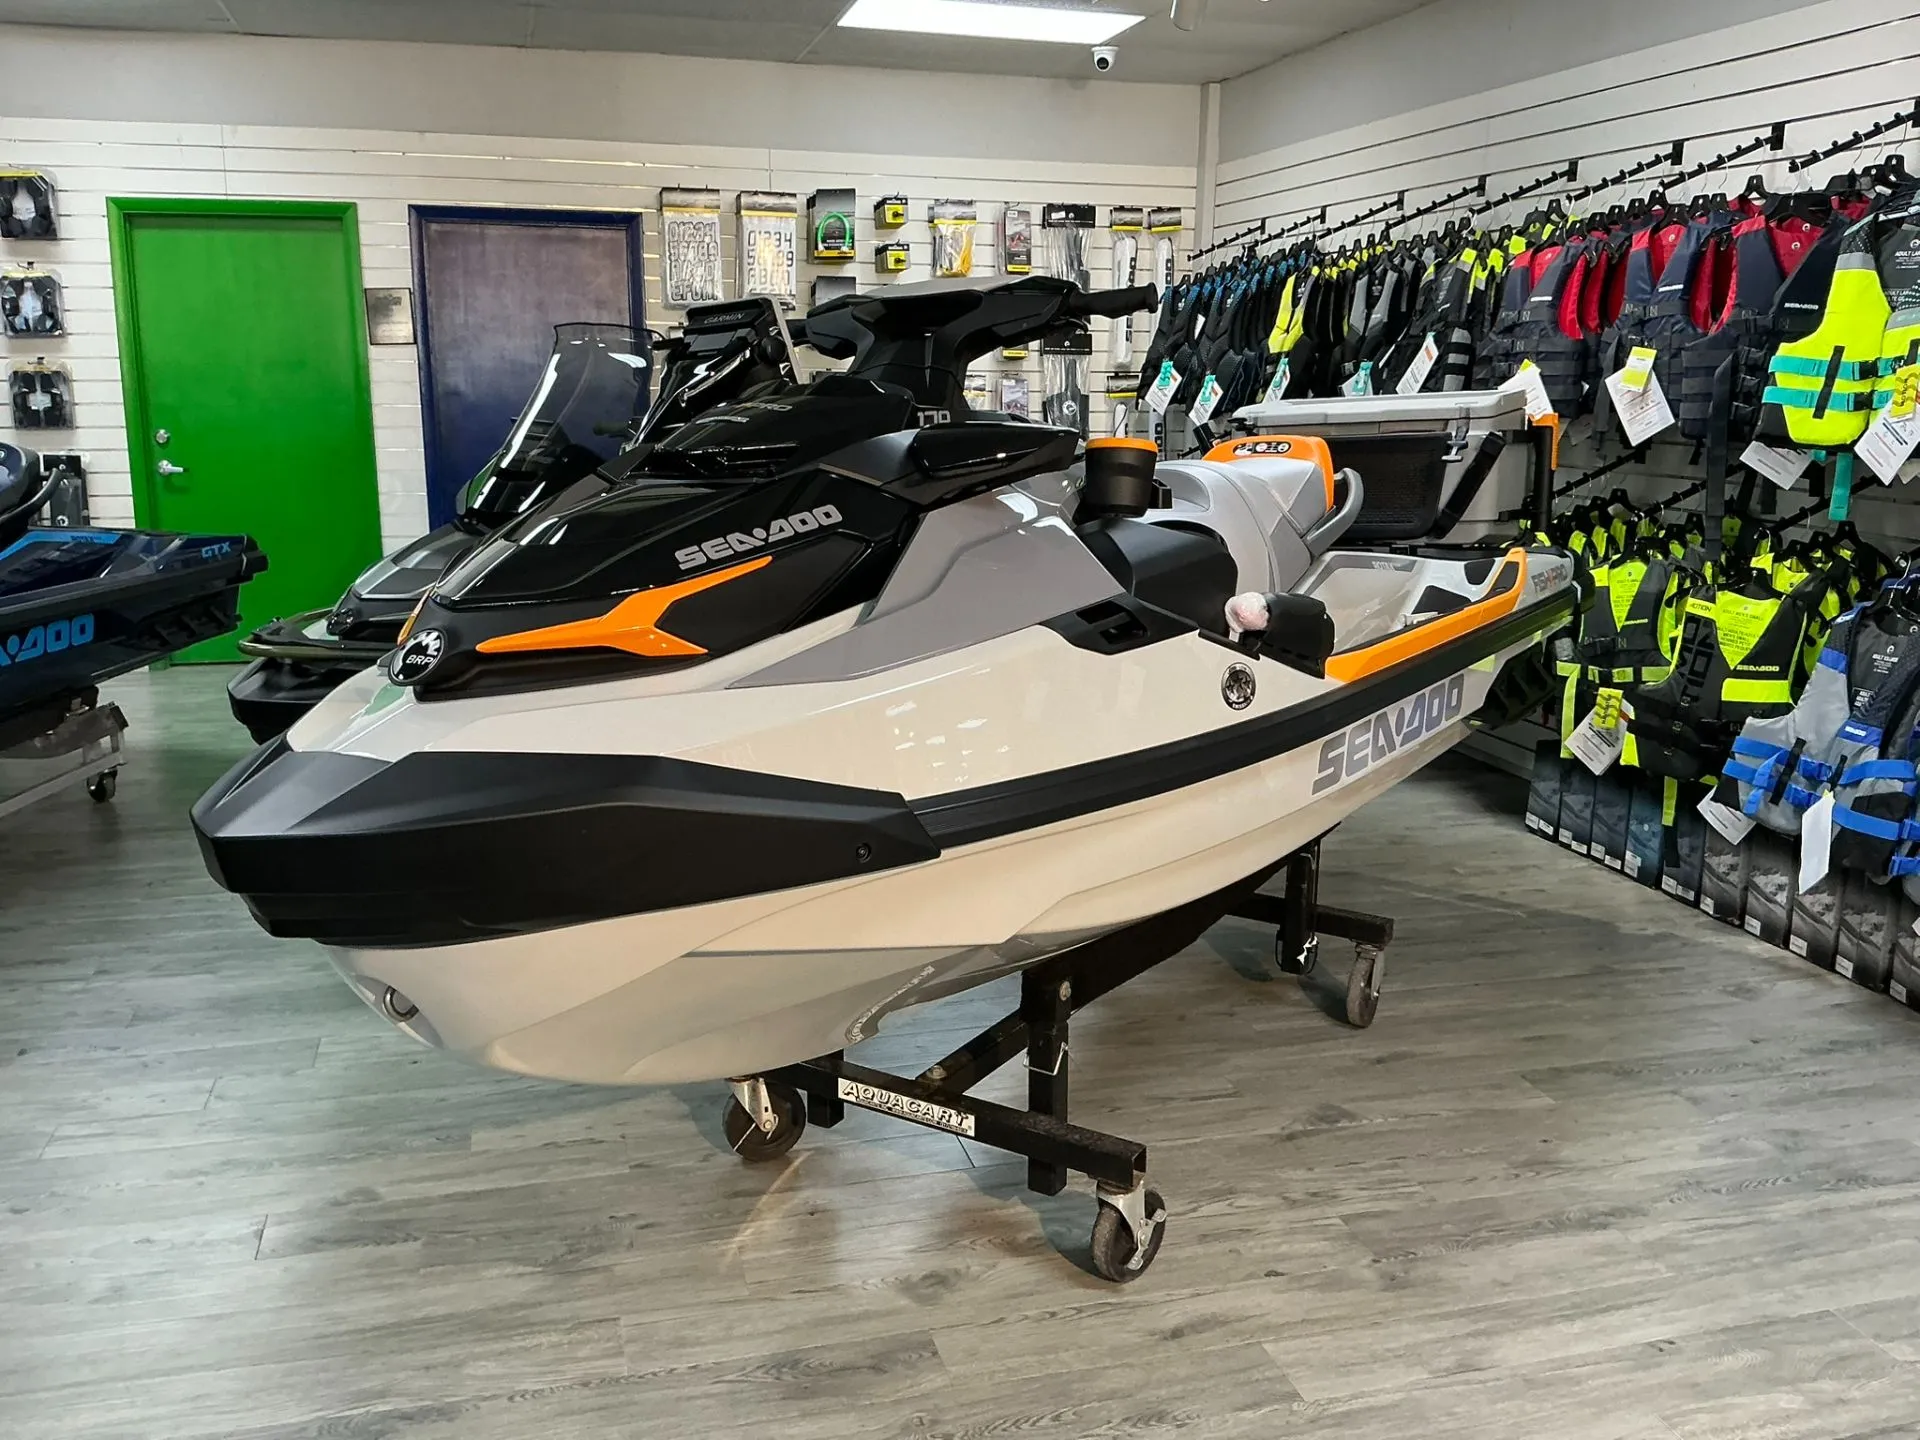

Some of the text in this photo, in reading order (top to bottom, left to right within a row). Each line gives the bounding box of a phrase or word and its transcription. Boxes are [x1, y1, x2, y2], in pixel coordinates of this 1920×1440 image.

[703, 312, 745, 324] GARMIN
[917, 410, 951, 427] 170
[201, 541, 231, 558] GTX
[405, 654, 434, 666] BRP
[842, 1081, 969, 1127] AQUACART
